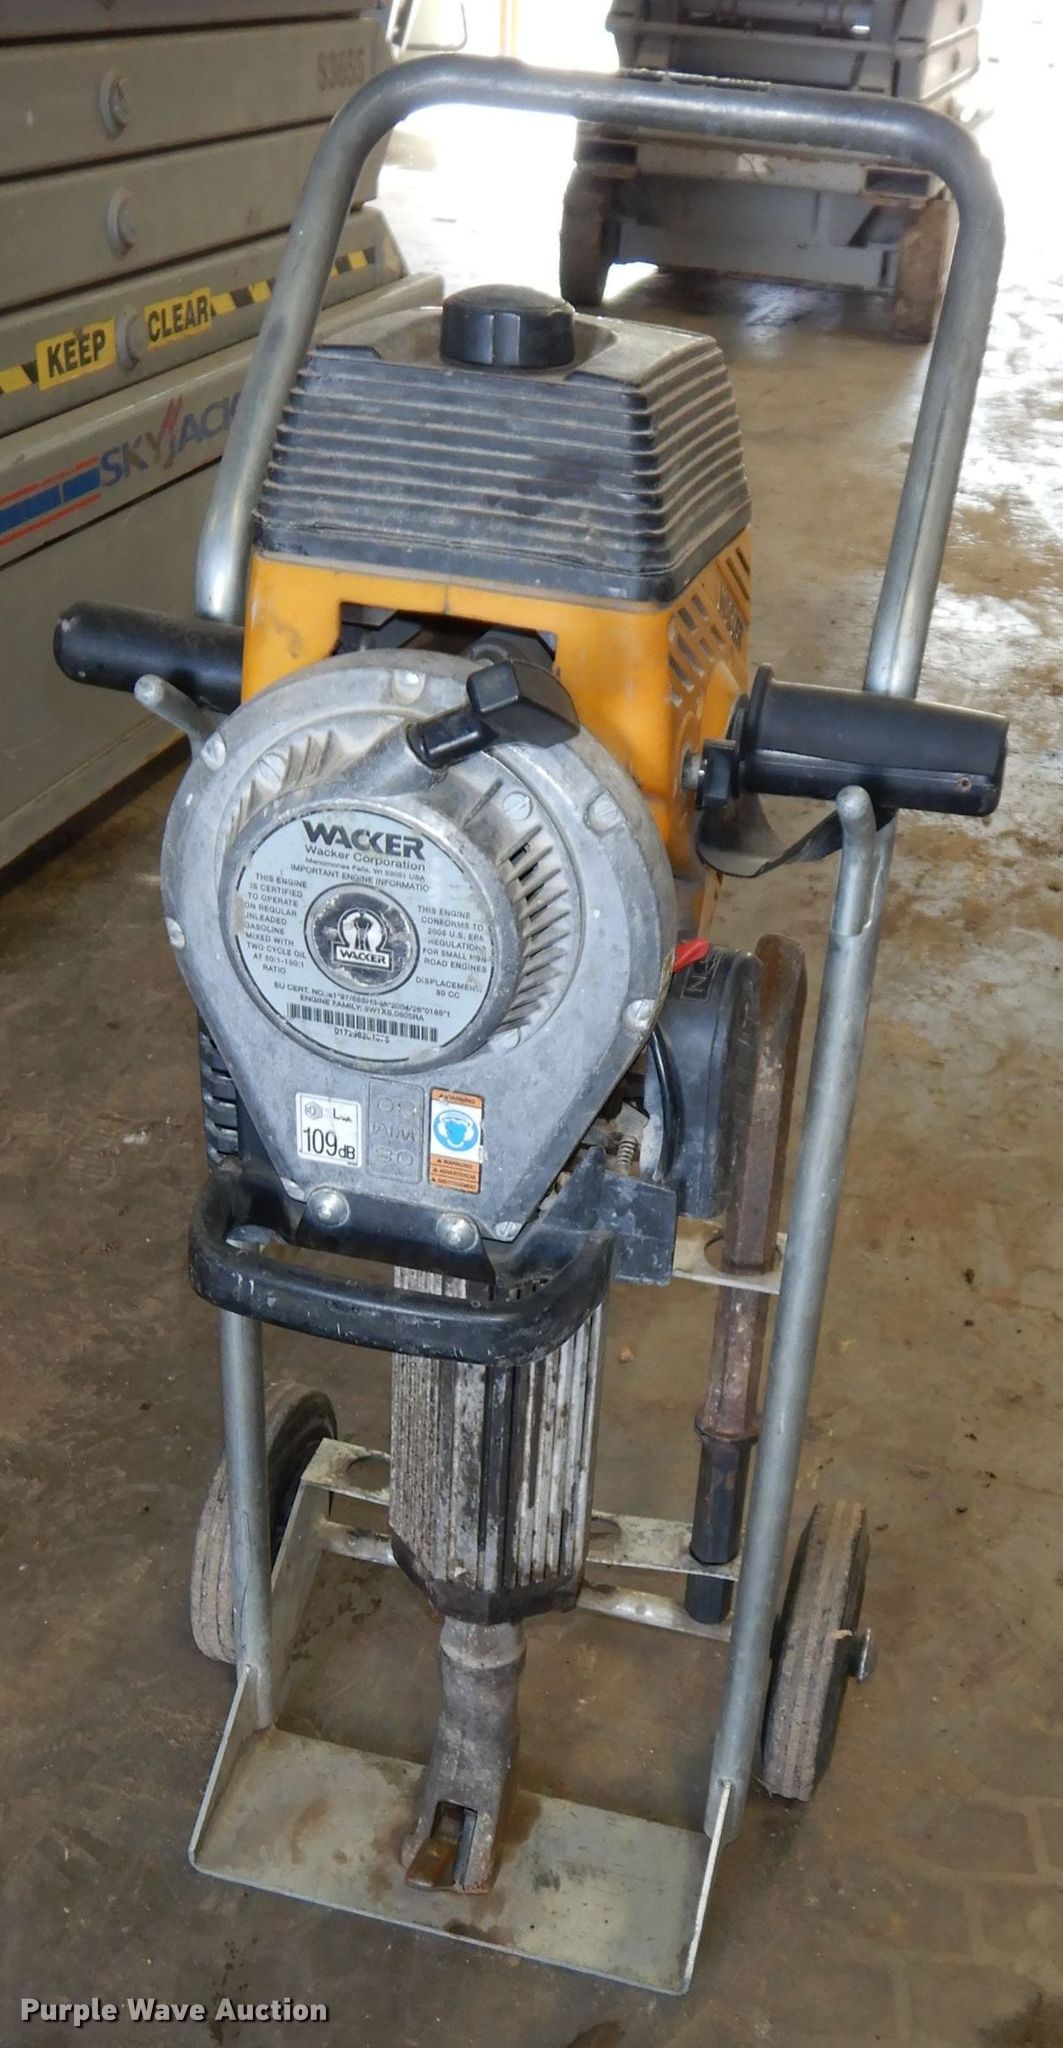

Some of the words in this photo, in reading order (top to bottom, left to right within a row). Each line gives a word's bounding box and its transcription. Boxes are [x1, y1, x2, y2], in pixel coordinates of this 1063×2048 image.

[47, 328, 107, 378] KEEP
[147, 295, 209, 343] CLEAR
[302, 820, 425, 860] WACKER
[305, 845, 350, 860] Wacker
[353, 852, 425, 871] Corporation
[256, 872, 274, 883] THIS
[276, 877, 307, 888] ENGINE
[290, 863, 339, 878] IMPORTANT
[342, 872, 373, 885] ENGINE
[409, 873, 425, 881] USA
[250, 882, 258, 890] IS
[260, 884, 303, 898] CERTIFIED
[248, 892, 258, 900] TO
[261, 894, 298, 907] OPERATE
[259, 904, 297, 917] REGULAR
[417, 904, 436, 914] THIS
[439, 908, 470, 919] ENGINE
[244, 912, 287, 925] UNLEADED
[421, 916, 470, 930] CONFORMS
[473, 923, 484, 931] TO
[244, 922, 285, 935] GASOLINE
[246, 932, 271, 942] MIXED
[274, 936, 294, 946] WITH
[449, 931, 466, 940] U.S.
[468, 933, 484, 942] EPA
[247, 941, 264, 951] TWO
[266, 944, 291, 956] CYCLE
[294, 950, 306, 959] OIL
[253, 952, 262, 960] AT
[340, 949, 386, 964] WACKER
[422, 947, 439, 956] FOR
[441, 950, 467, 960] SMALL
[263, 963, 286, 974] RATIO
[424, 957, 448, 967] ROAD
[450, 960, 487, 974] ENGINES
[274, 981, 285, 989] EU
[287, 984, 310, 994] CERT.
[448, 990, 460, 999] CC
[300, 994, 330, 1006] ENGINE
[332, 1000, 362, 1011] FAMILY:
